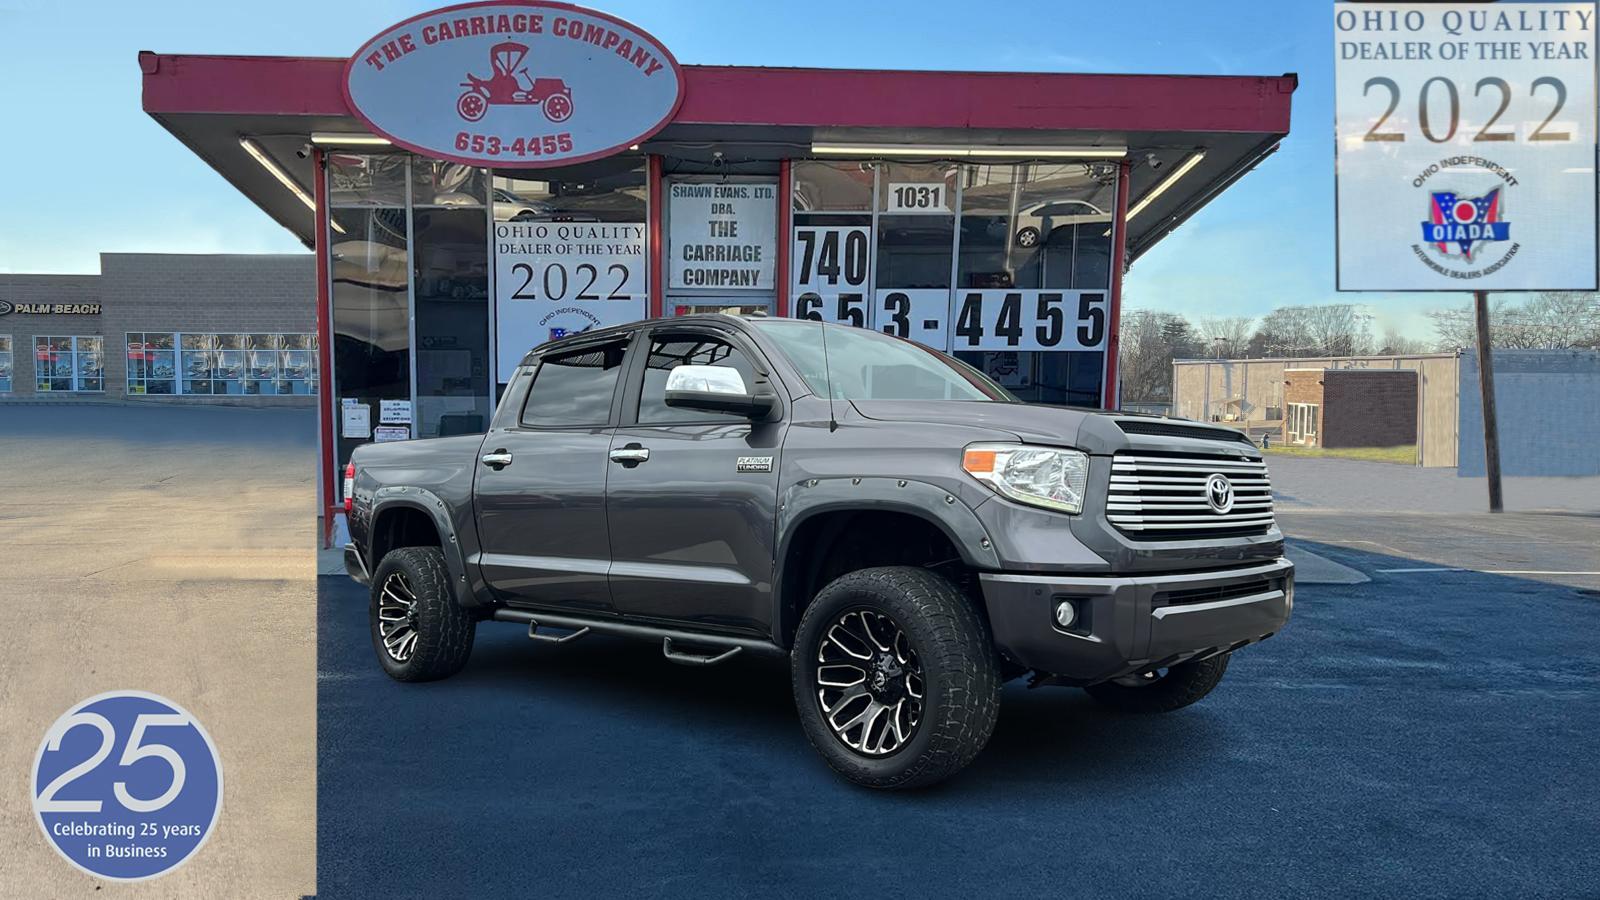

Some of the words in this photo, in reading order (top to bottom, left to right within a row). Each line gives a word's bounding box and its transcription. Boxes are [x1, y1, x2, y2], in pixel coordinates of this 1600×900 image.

[1336, 10, 1425, 31] OHIO
[1442, 10, 1592, 35] QUALITY
[365, 33, 416, 71] THE
[422, 15, 544, 45] CARRIAGE
[552, 16, 664, 77] COMPANY
[1340, 42, 1433, 60] DEALER
[1438, 42, 1469, 60] OF
[1474, 42, 1522, 60] THE
[1527, 42, 1589, 60] YEAR
[1362, 76, 1570, 143] 2022
[455, 131, 573, 156] 653-4455
[1412, 163, 1439, 188] OHIO
[1440, 155, 1519, 188] INDEPENDENT
[673, 186, 712, 198] SHAWN
[754, 187, 775, 199] LTD.
[894, 187, 941, 208] 1031
[711, 203, 736, 215] DBA.
[497, 226, 548, 239] OHIO
[557, 226, 644, 241] QUALITY
[708, 220, 738, 237] THE
[1432, 224, 1495, 240] OIADA
[499, 243, 552, 255] DEALER
[555, 244, 573, 255] OF
[576, 244, 603, 255] THE
[606, 244, 641, 255] YEAR
[683, 244, 762, 262] CARRIAGE
[796, 229, 868, 287] 740
[1411, 243, 1450, 276] AUTOMOBILE
[1450, 270, 1482, 280] DEALERS
[1483, 242, 1521, 276] ASSOCIATION
[511, 262, 631, 301] 2022
[683, 268, 760, 286] COMPANY
[15, 304, 50, 314] PALM
[54, 304, 100, 314] BEACH
[539, 312, 555, 327] OHIO
[555, 307, 601, 326] INDEPENDENT
